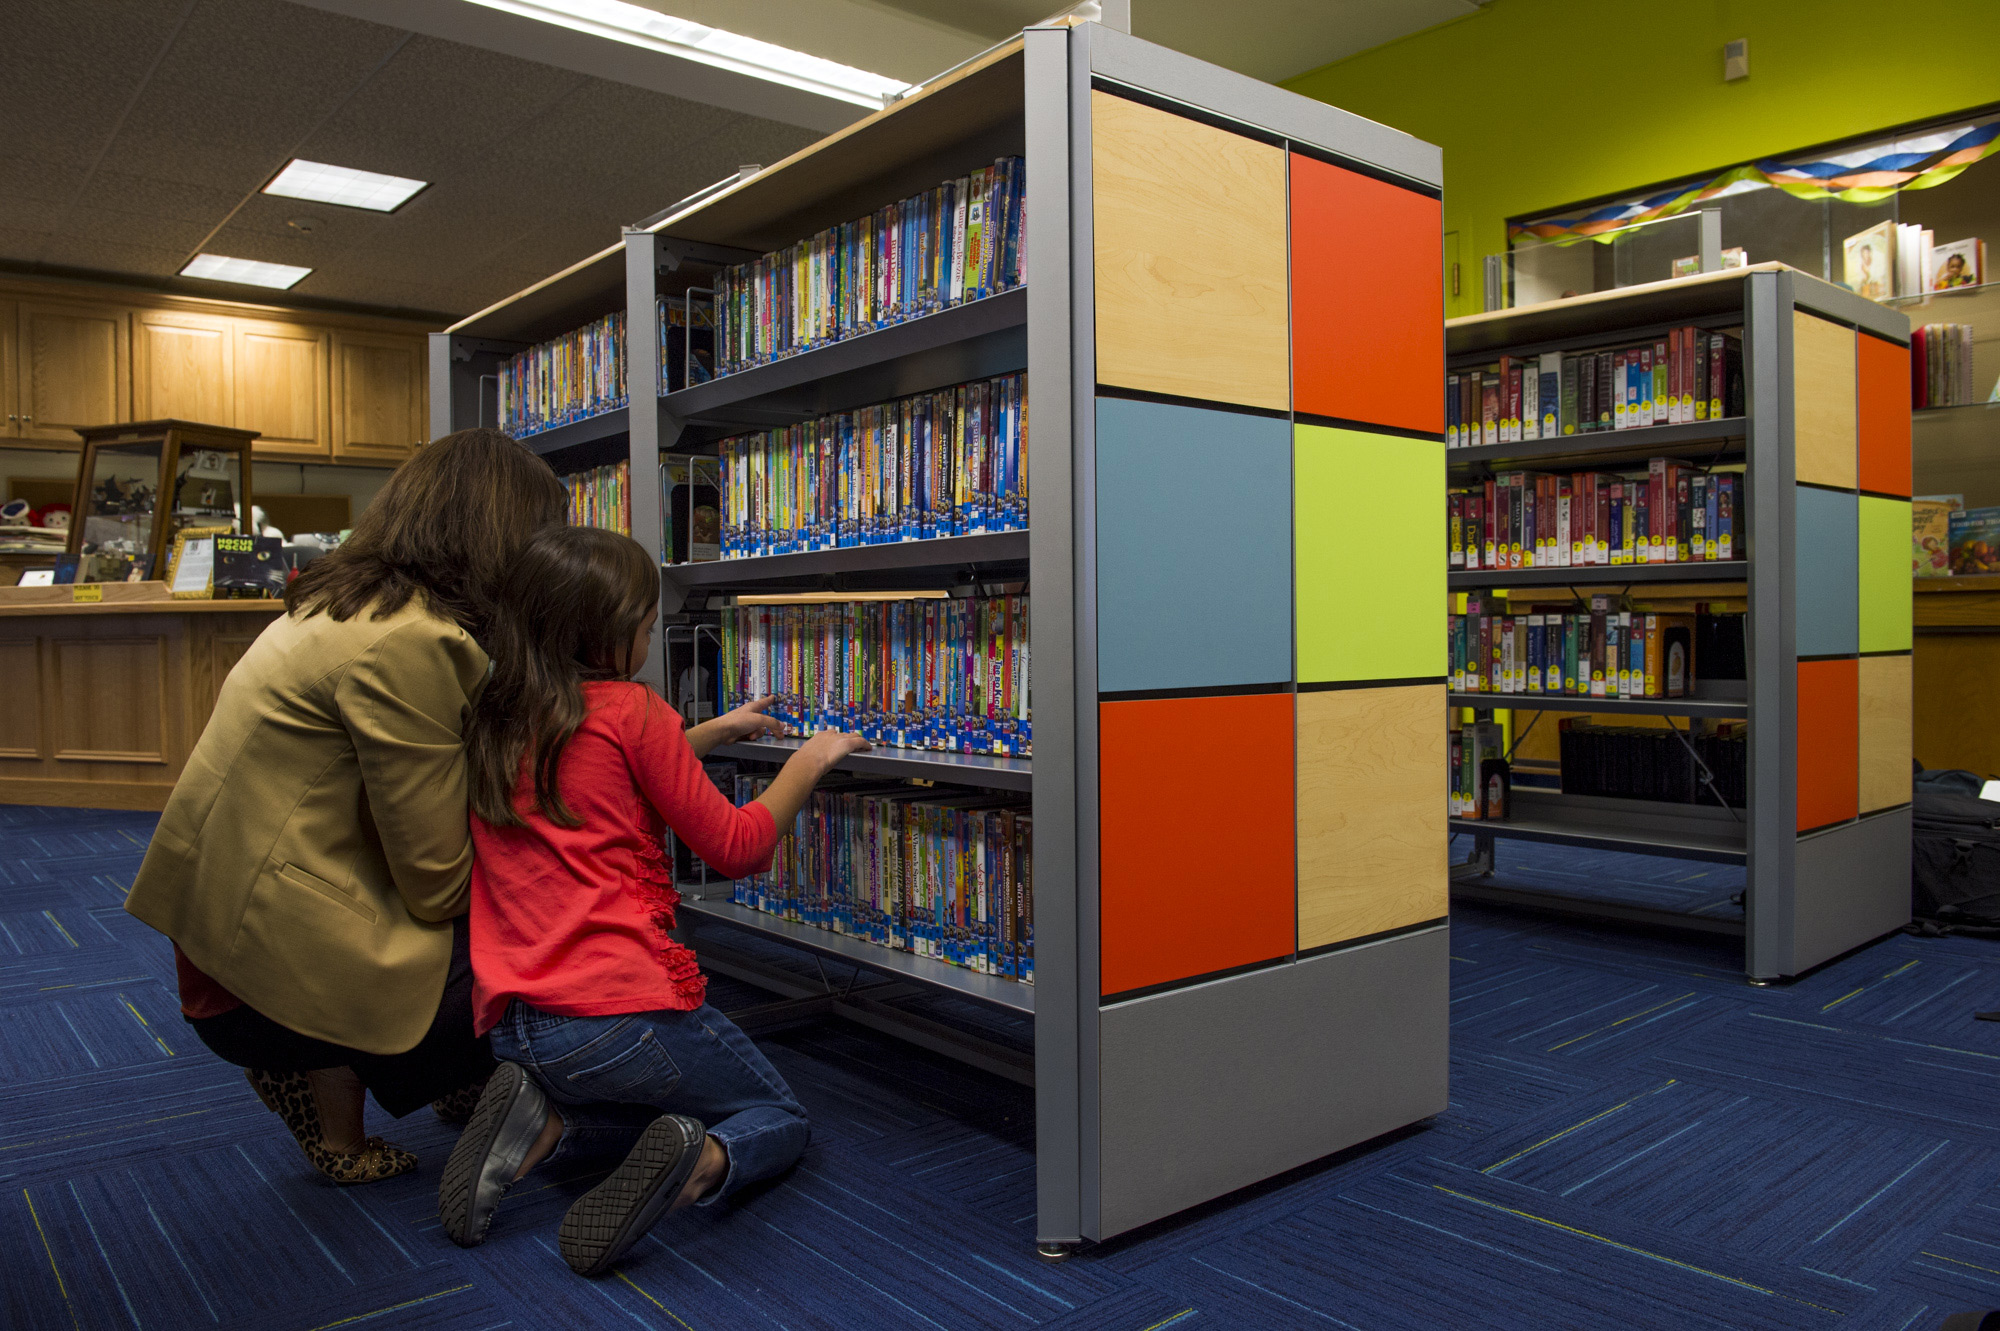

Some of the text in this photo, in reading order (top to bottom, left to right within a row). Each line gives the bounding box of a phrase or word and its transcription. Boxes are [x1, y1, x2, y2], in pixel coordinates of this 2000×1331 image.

[981, 237, 989, 289] ADVENTURES
[787, 660, 792, 672] MY
[835, 675, 841, 686] TO
[994, 689, 1003, 709] KIC
